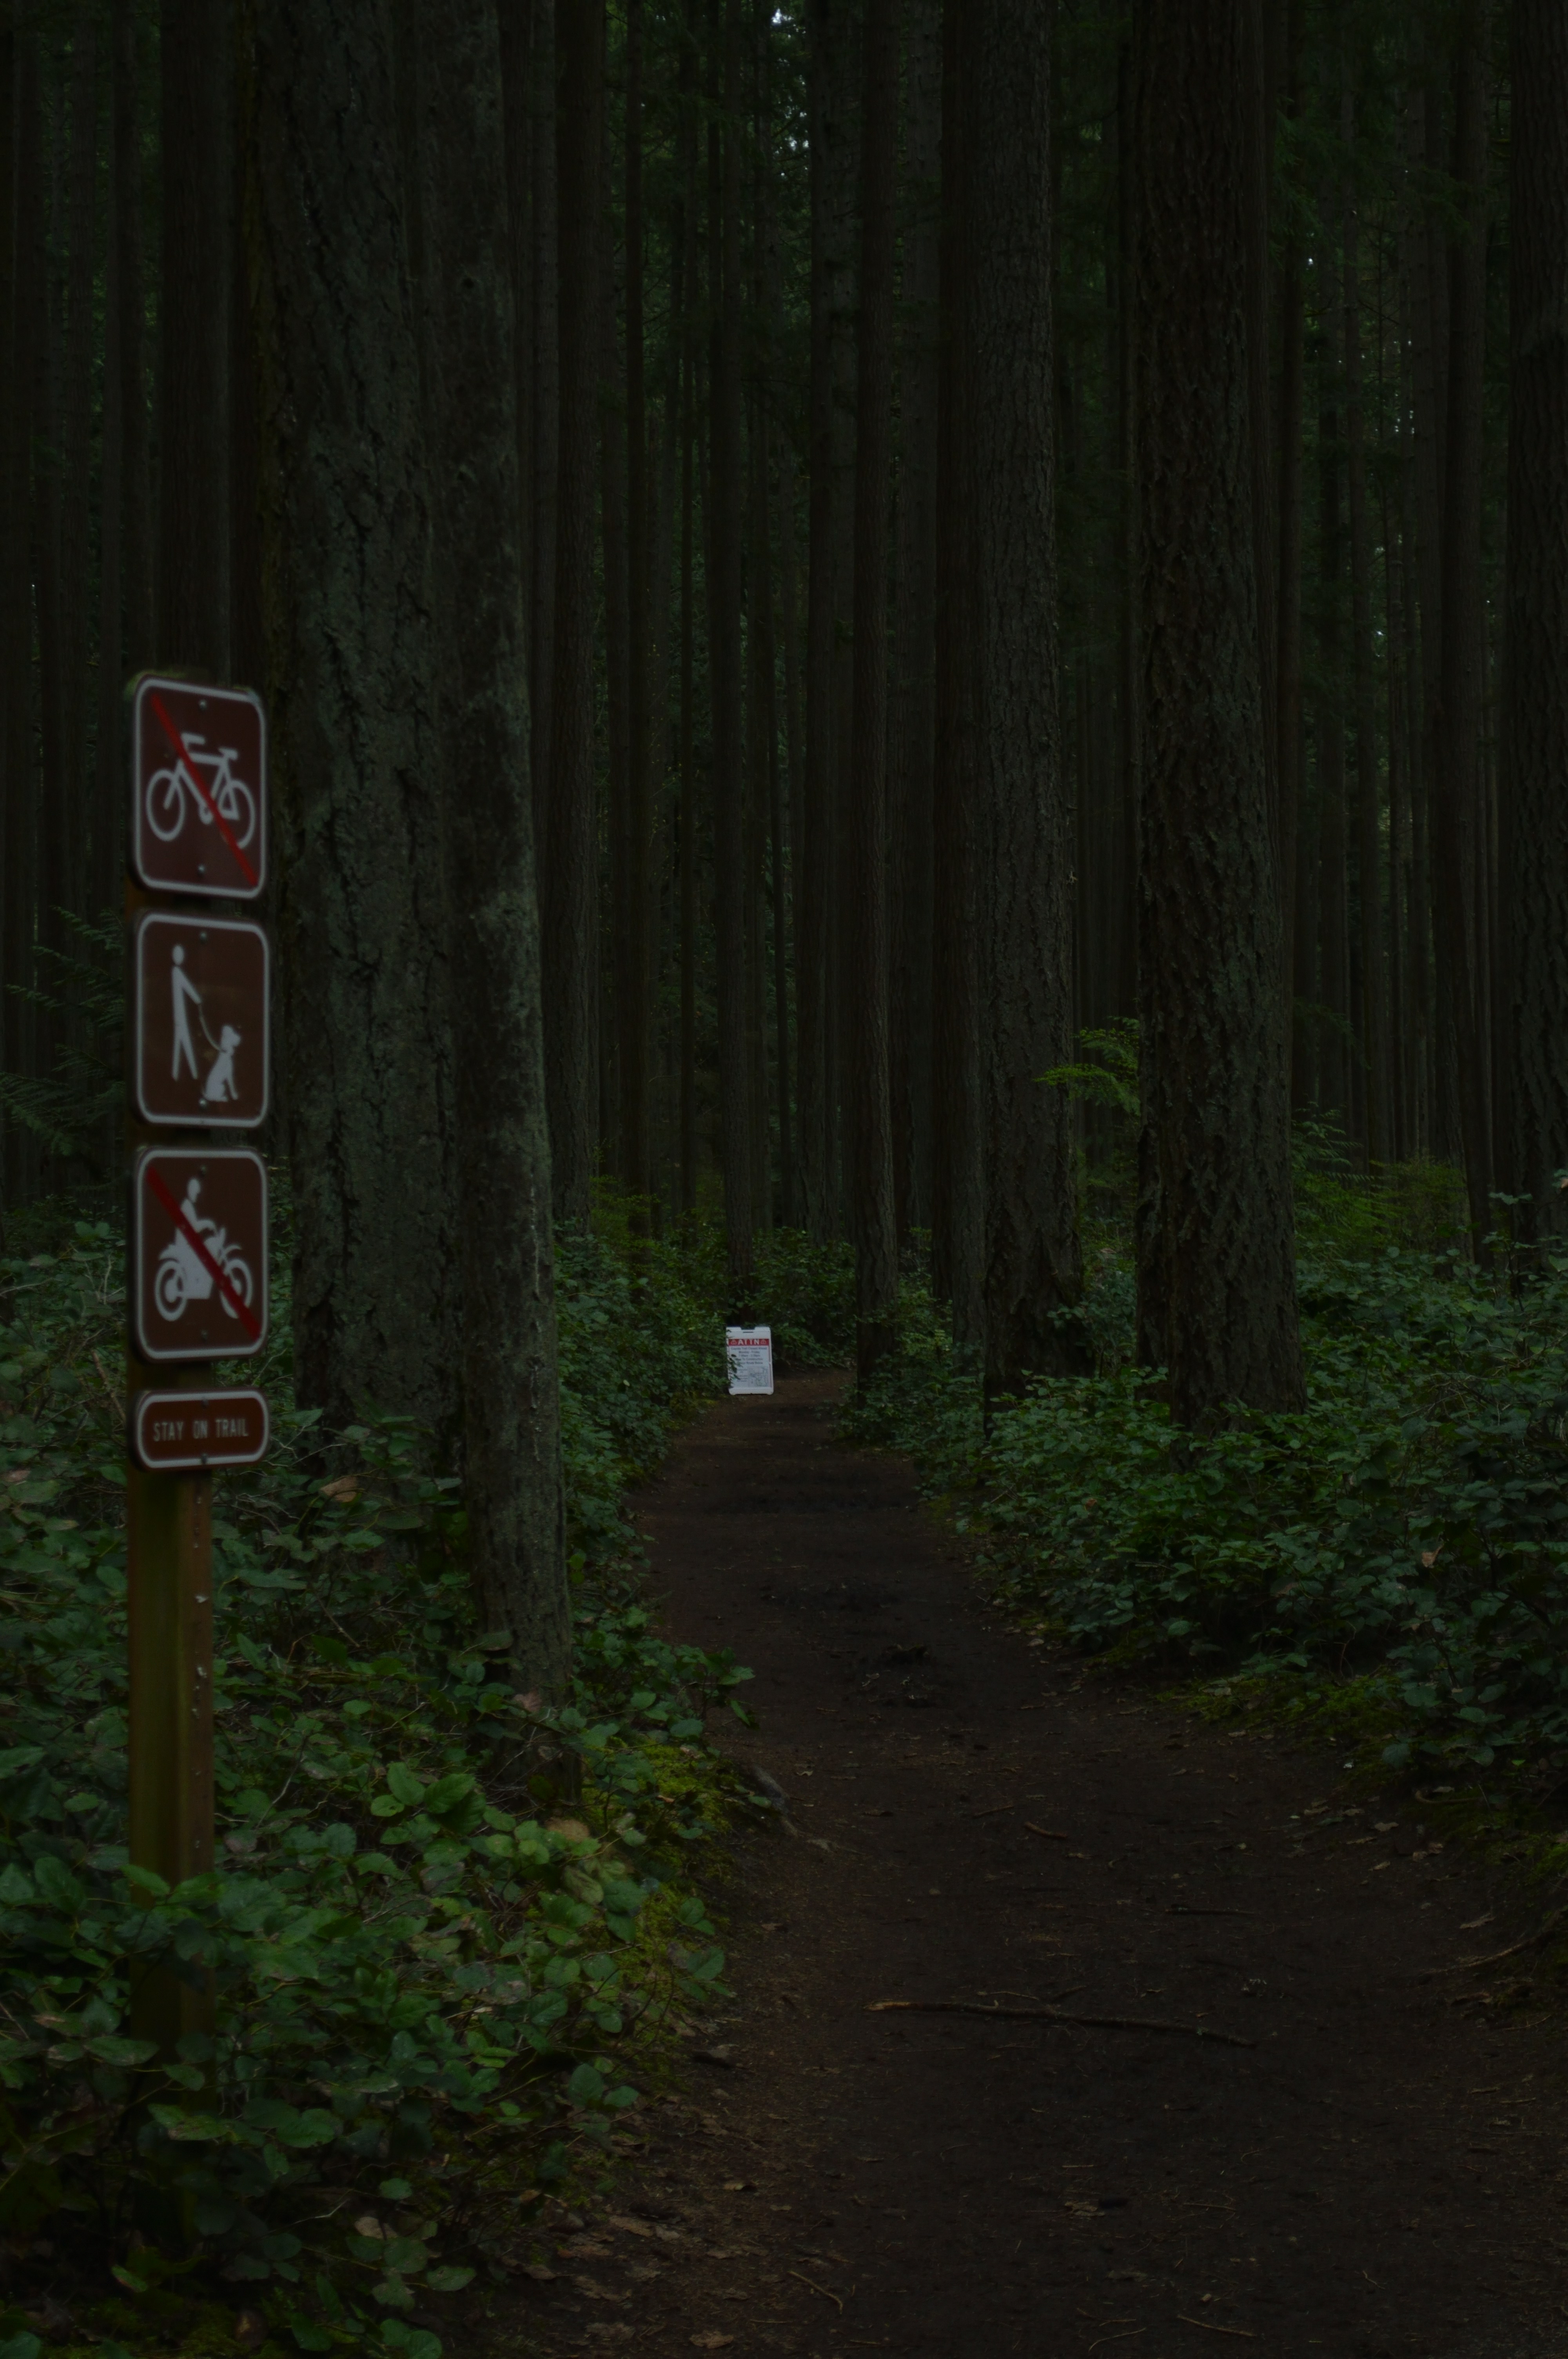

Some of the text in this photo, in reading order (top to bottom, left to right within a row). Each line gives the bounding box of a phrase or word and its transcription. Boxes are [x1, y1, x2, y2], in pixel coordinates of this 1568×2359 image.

[152, 1418, 249, 1442] STAY ON TRAIL
